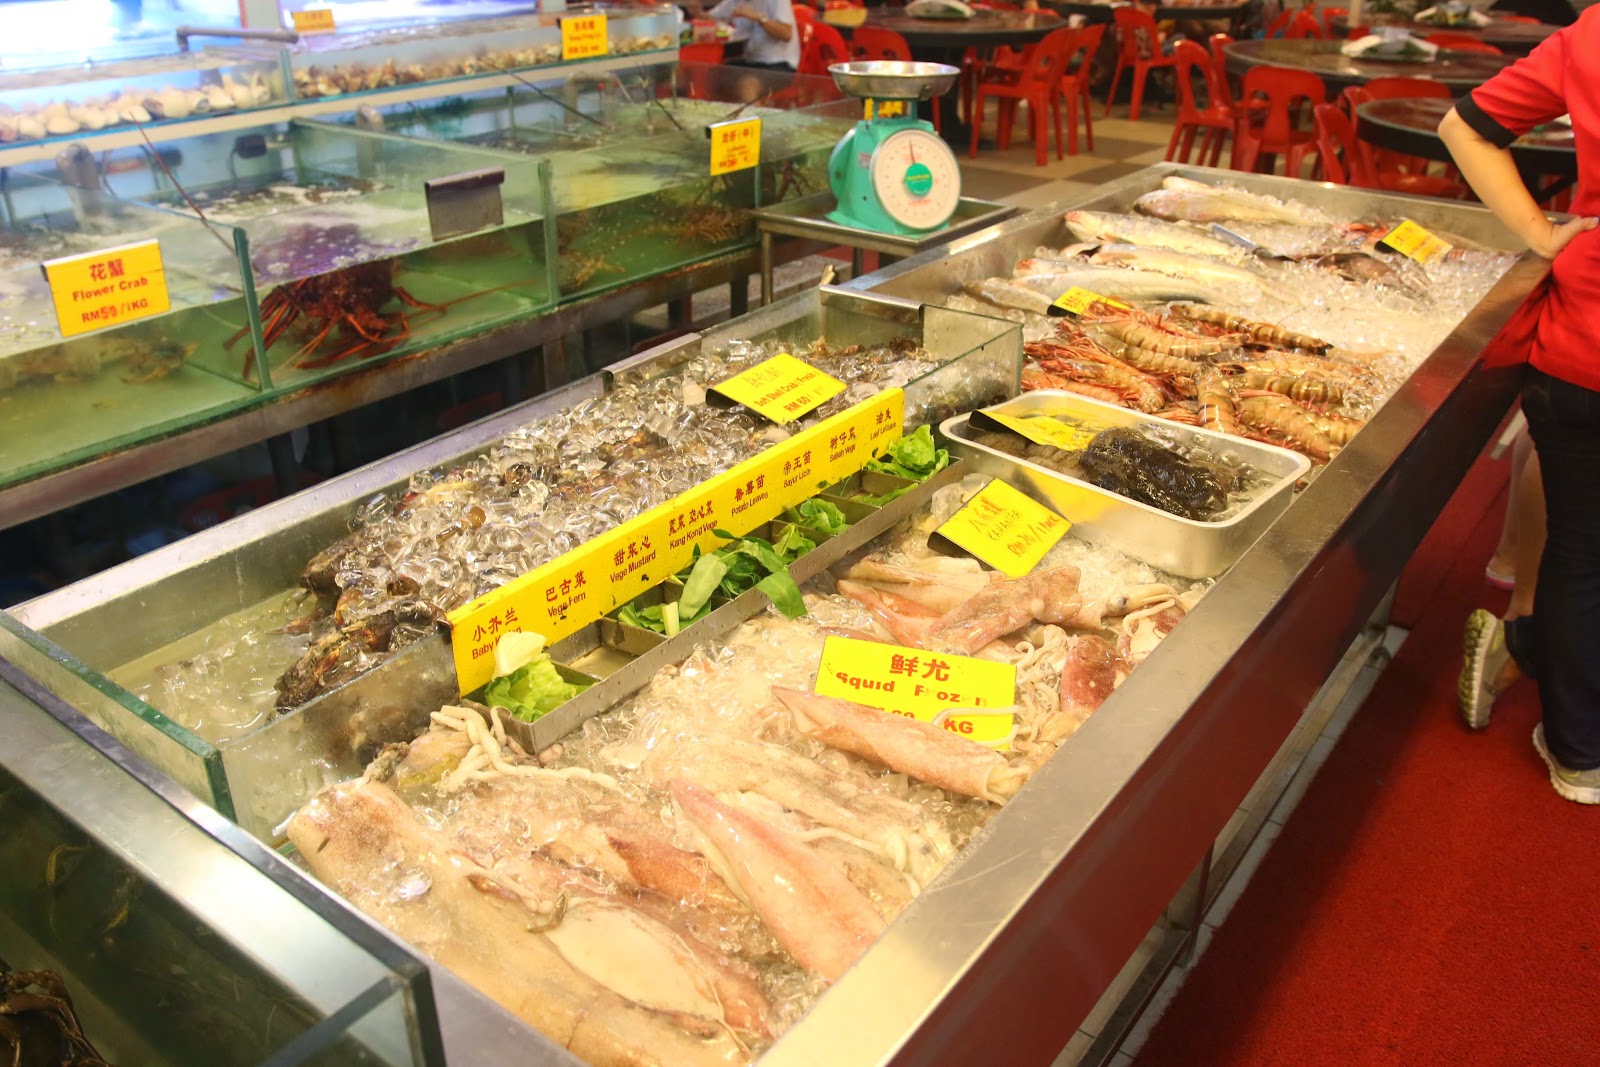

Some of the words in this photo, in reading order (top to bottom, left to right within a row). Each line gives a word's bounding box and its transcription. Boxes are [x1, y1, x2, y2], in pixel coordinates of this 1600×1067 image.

[89, 258, 125, 281] 花蟹
[72, 284, 115, 302] Flower
[118, 276, 148, 292] Crab
[783, 449, 812, 476] 帝王苗
[731, 503, 749, 517] Potato
[749, 491, 769, 507] Leaves
[669, 535, 686, 550] Kang
[686, 528, 703, 543] Kong
[701, 519, 718, 532] Vege
[613, 535, 651, 567] 甜菜心
[610, 564, 628, 583] Vege
[628, 550, 656, 573] Mustard
[545, 570, 587, 602] 巴古菜
[547, 602, 568, 618] Vege
[568, 591, 586, 608] Fern
[472, 607, 518, 642] 小芥兰
[472, 641, 494, 660] Baby
[889, 653, 951, 682] 鲜尤
[835, 671, 896, 693] Squid
